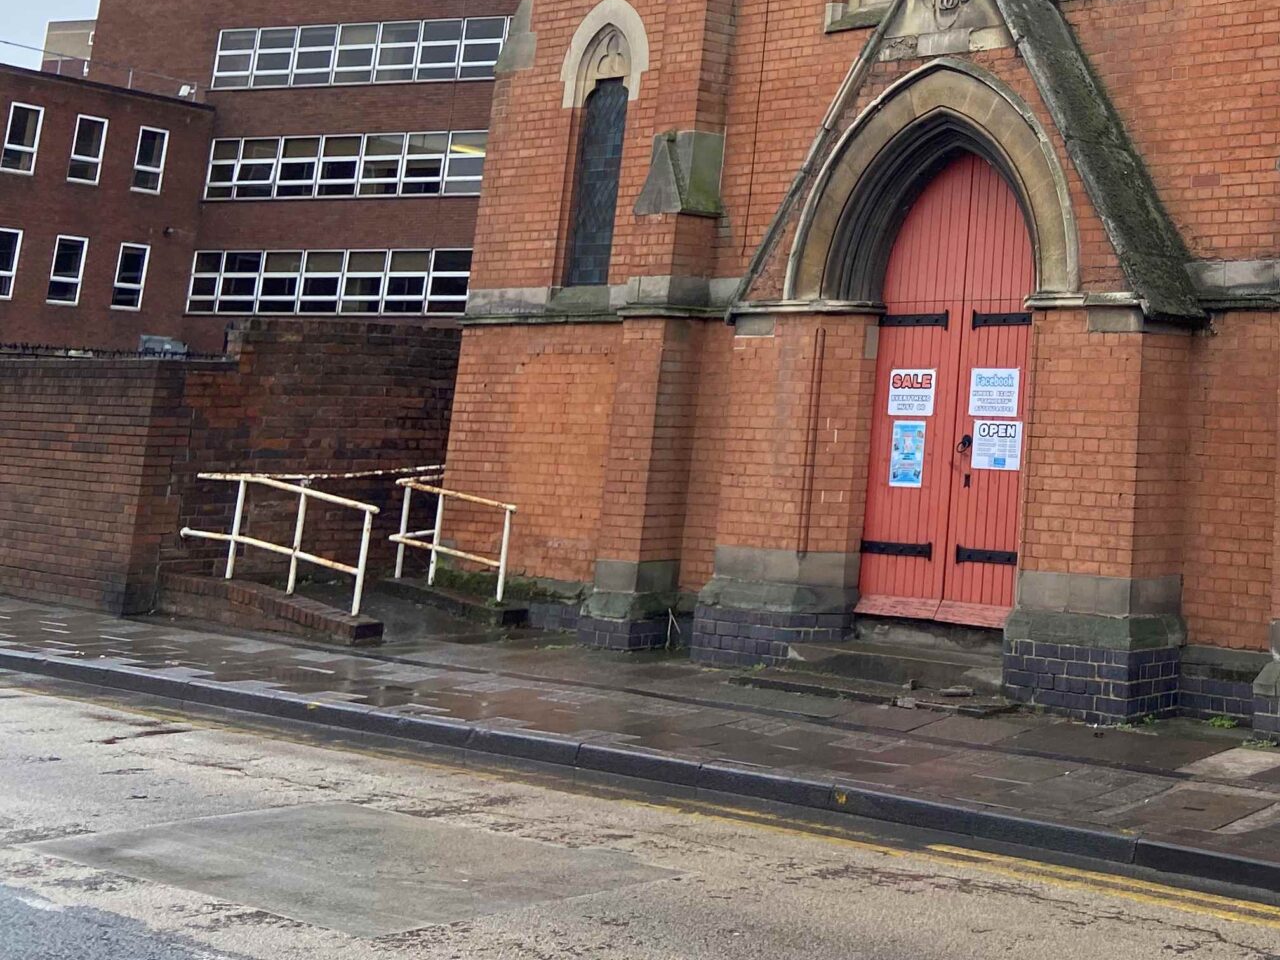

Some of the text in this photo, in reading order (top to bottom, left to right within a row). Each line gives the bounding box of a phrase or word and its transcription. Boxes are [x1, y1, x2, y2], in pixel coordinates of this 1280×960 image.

[892, 373, 933, 389] SALE
[975, 374, 1014, 387] Facebook
[979, 423, 1016, 438] OPEN
